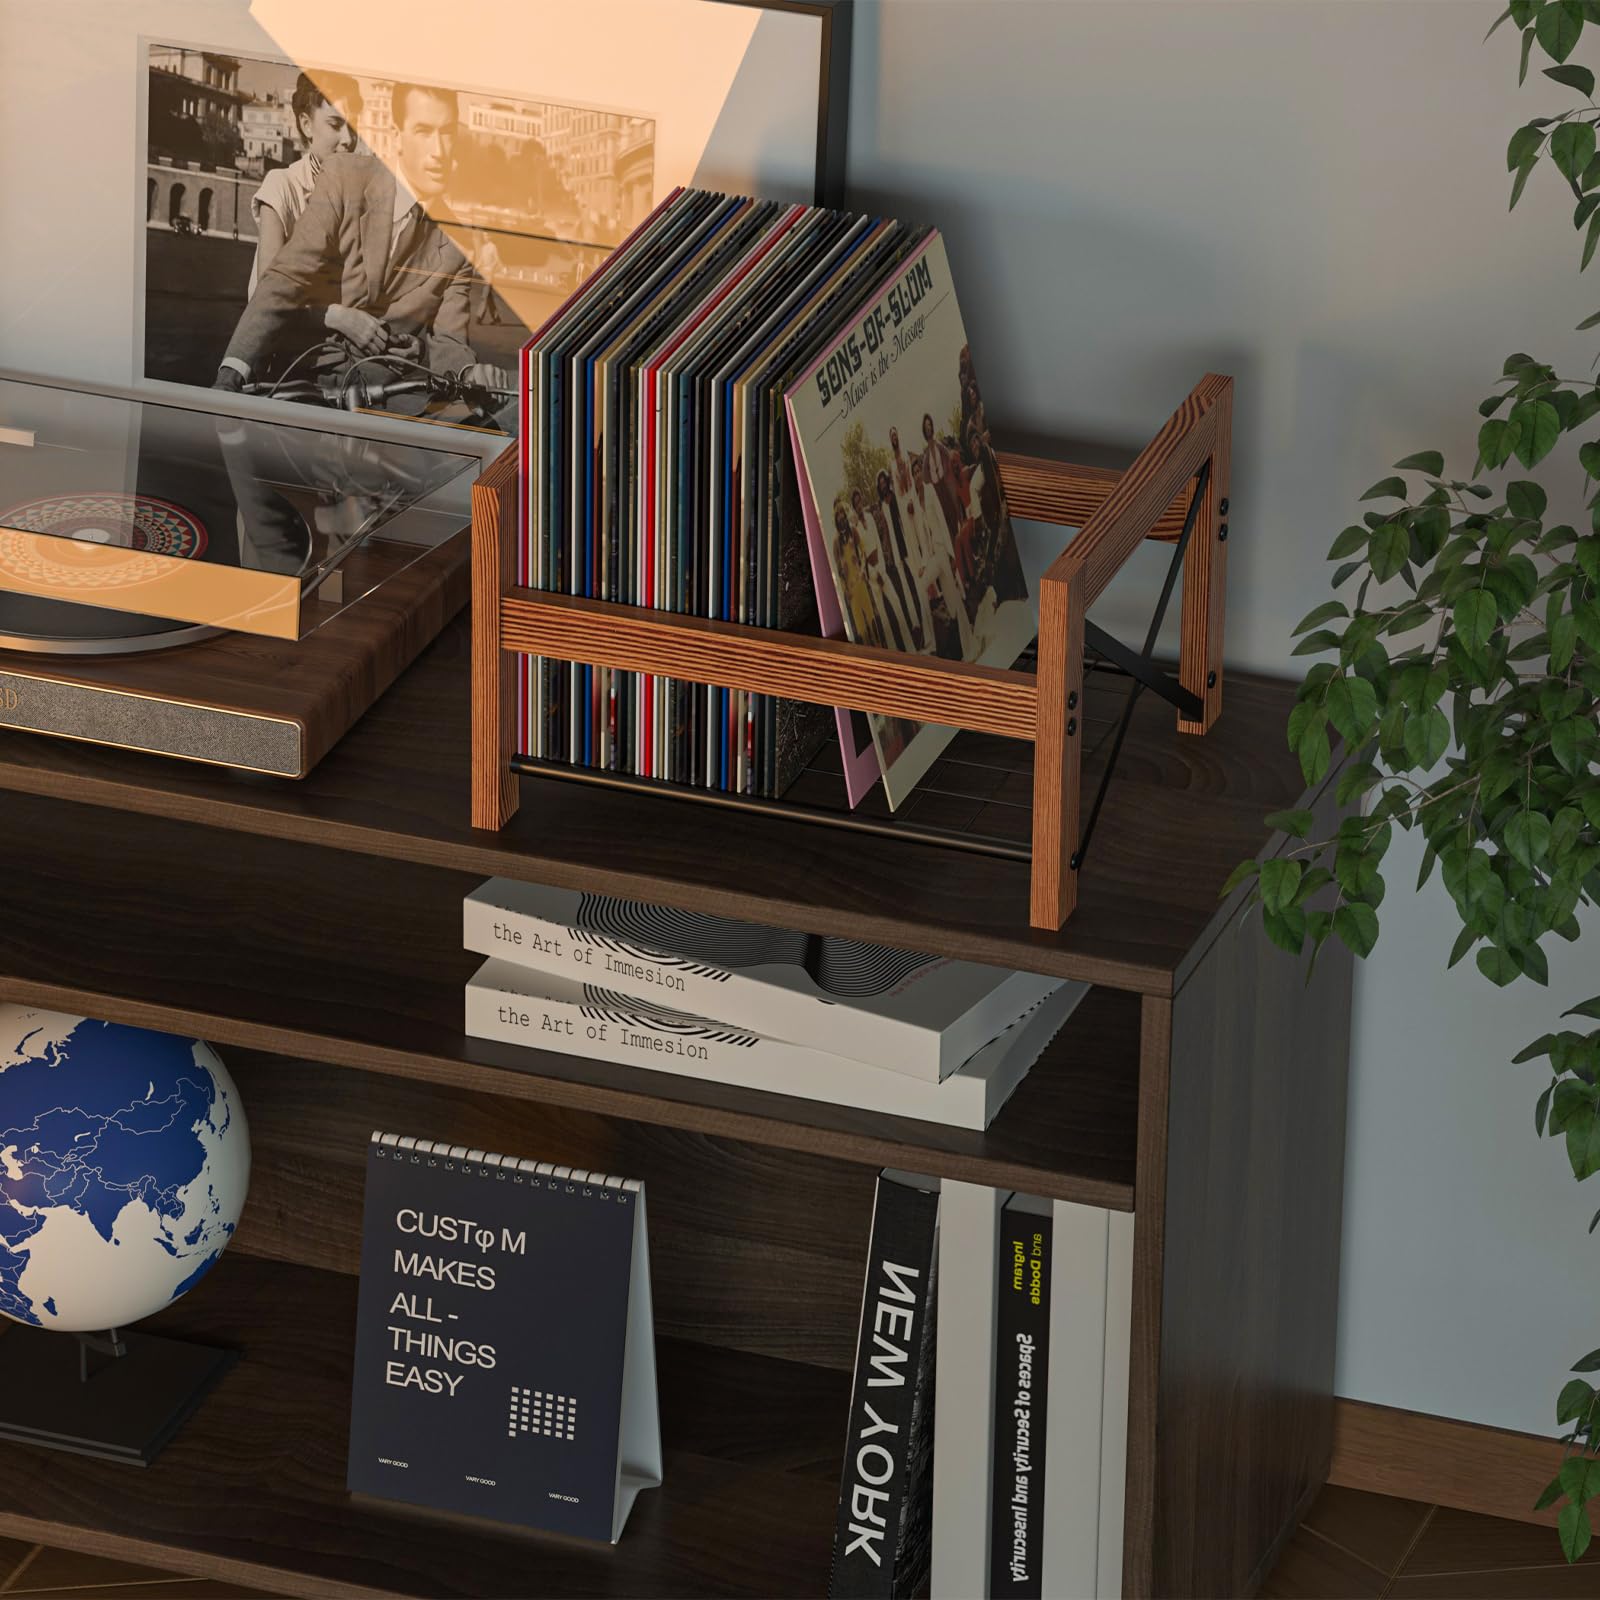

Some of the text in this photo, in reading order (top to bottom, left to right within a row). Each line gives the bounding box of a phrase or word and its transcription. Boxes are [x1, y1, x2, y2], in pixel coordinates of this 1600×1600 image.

[840, 314, 926, 418] Music is the Message
[493, 922, 686, 992] the Art of Immesion
[498, 1006, 708, 1060] the Art of Immesion
[393, 1249, 497, 1291] MAKES
[389, 1292, 443, 1323] ALL
[387, 1326, 497, 1369] THINGS
[385, 1361, 465, 1397] EASY
[392, 1460, 409, 1469] GOOD
[480, 1478, 496, 1487] GOOD
[562, 1495, 580, 1503] GOOD
